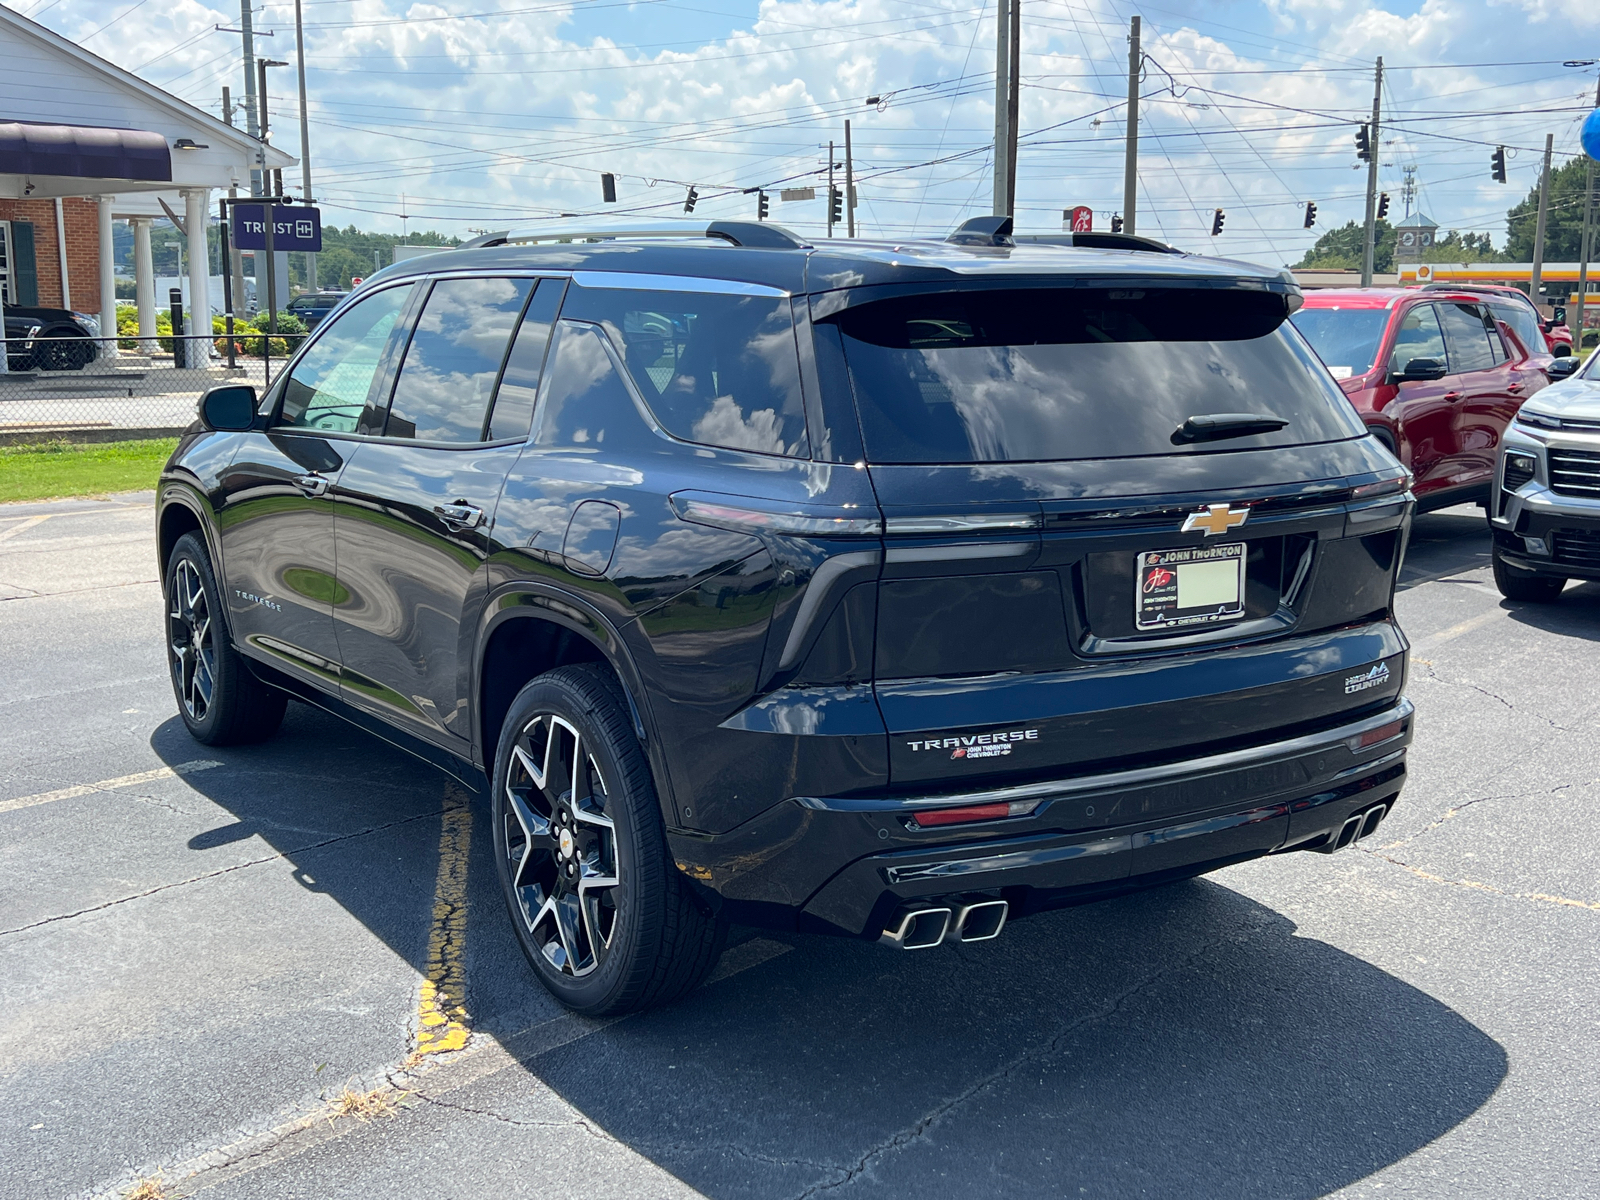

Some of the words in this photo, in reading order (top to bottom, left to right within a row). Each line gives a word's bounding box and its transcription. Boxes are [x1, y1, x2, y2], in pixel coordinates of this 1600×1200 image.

[1164, 550, 1190, 562] JOHN
[235, 589, 281, 612] TRAVERSE
[1177, 616, 1208, 625] CHEVROLET
[1345, 674, 1389, 694] COUNTRY
[907, 729, 1038, 751] TRAVERSE
[982, 743, 1012, 752] THORNTON
[966, 750, 1001, 759] CHEVROLET
